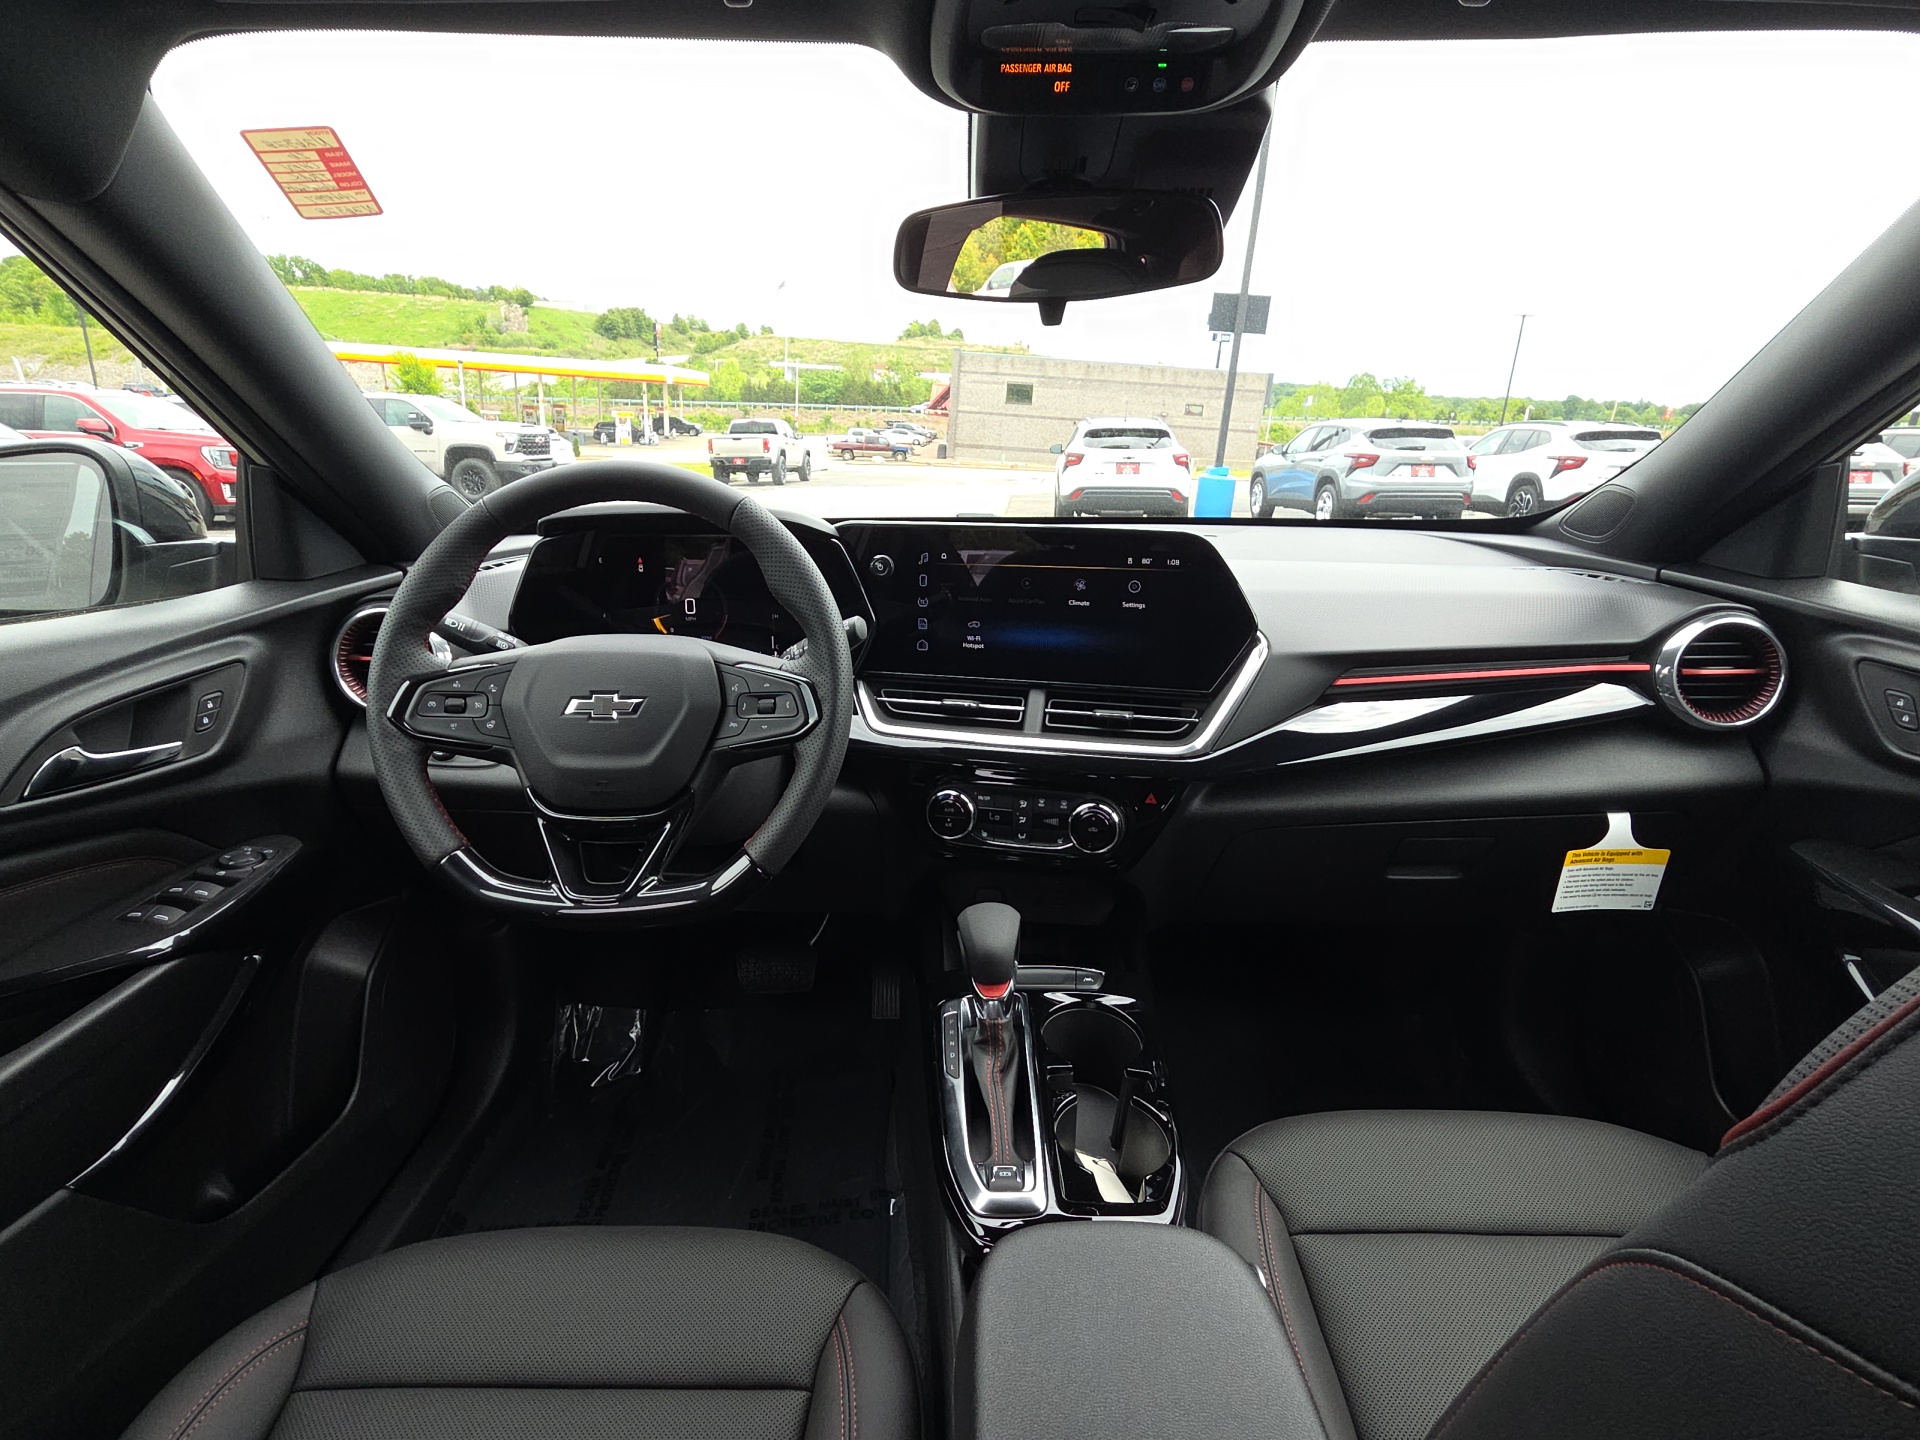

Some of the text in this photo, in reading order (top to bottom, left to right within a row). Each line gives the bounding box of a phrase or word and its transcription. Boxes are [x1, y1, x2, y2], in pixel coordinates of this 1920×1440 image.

[1000, 63, 1072, 74] PASSENGER AIR BAG
[1053, 80, 1071, 92] OFF
[1068, 598, 1090, 607] Climate
[1122, 600, 1146, 610] Settings
[962, 641, 985, 650] Hotspot
